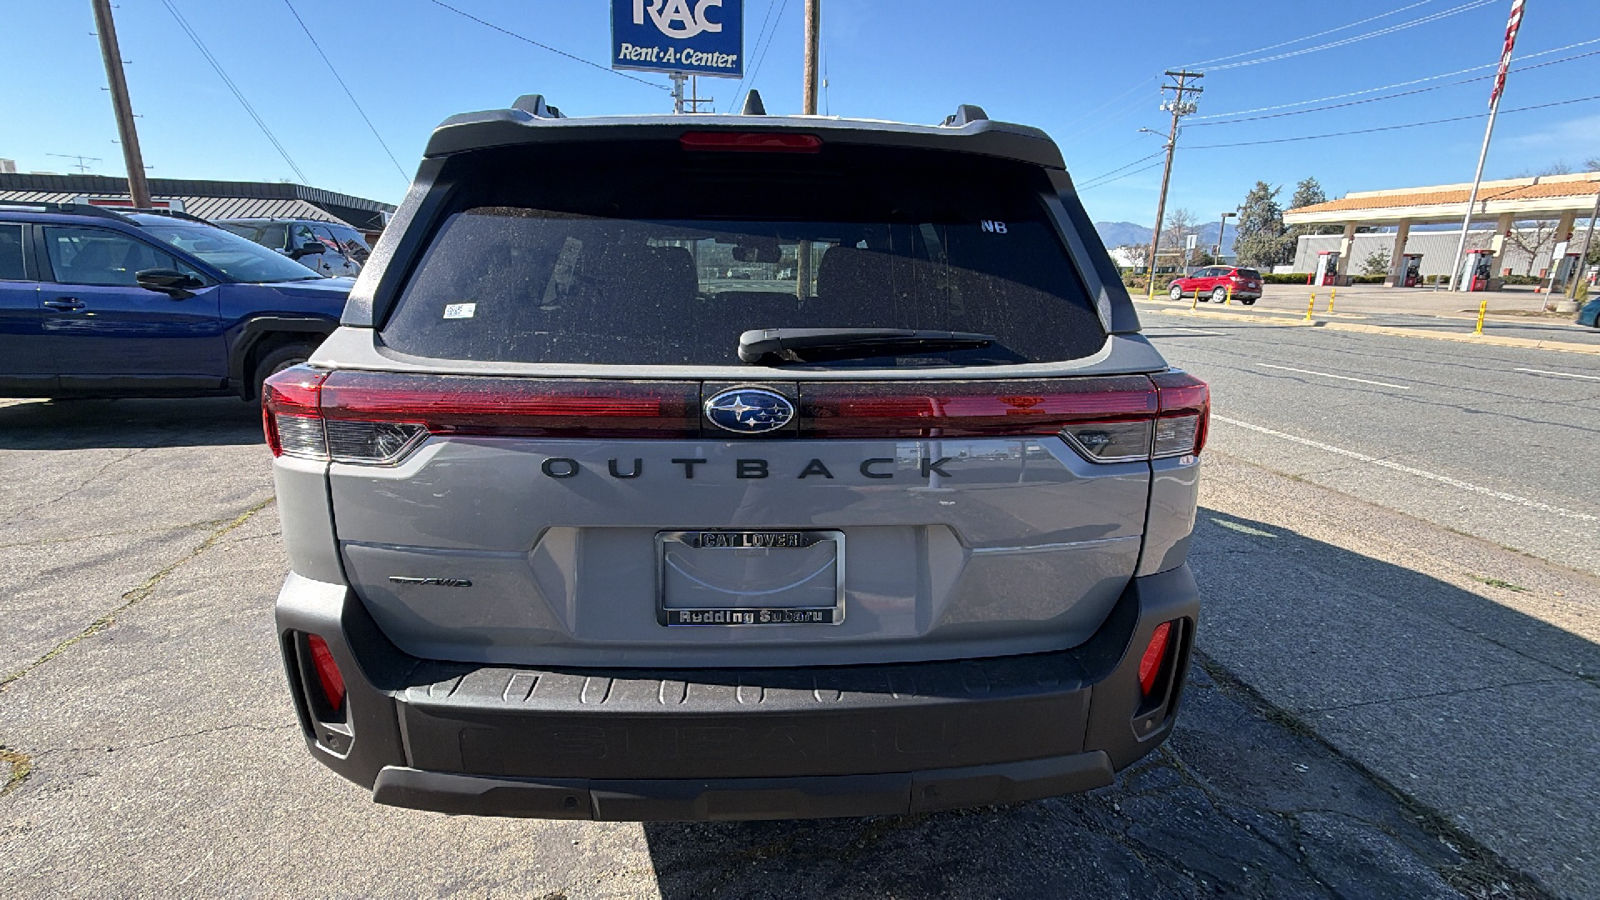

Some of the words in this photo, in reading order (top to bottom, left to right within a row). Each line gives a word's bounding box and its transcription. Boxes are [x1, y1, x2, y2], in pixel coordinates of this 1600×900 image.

[632, 0, 723, 39] RAC
[980, 219, 1008, 234] NB
[541, 456, 953, 479] OUTBACK
[703, 533, 737, 547] CAT
[742, 533, 798, 547] LOVER
[679, 610, 754, 624] Redding
[759, 609, 823, 623] Subaru
